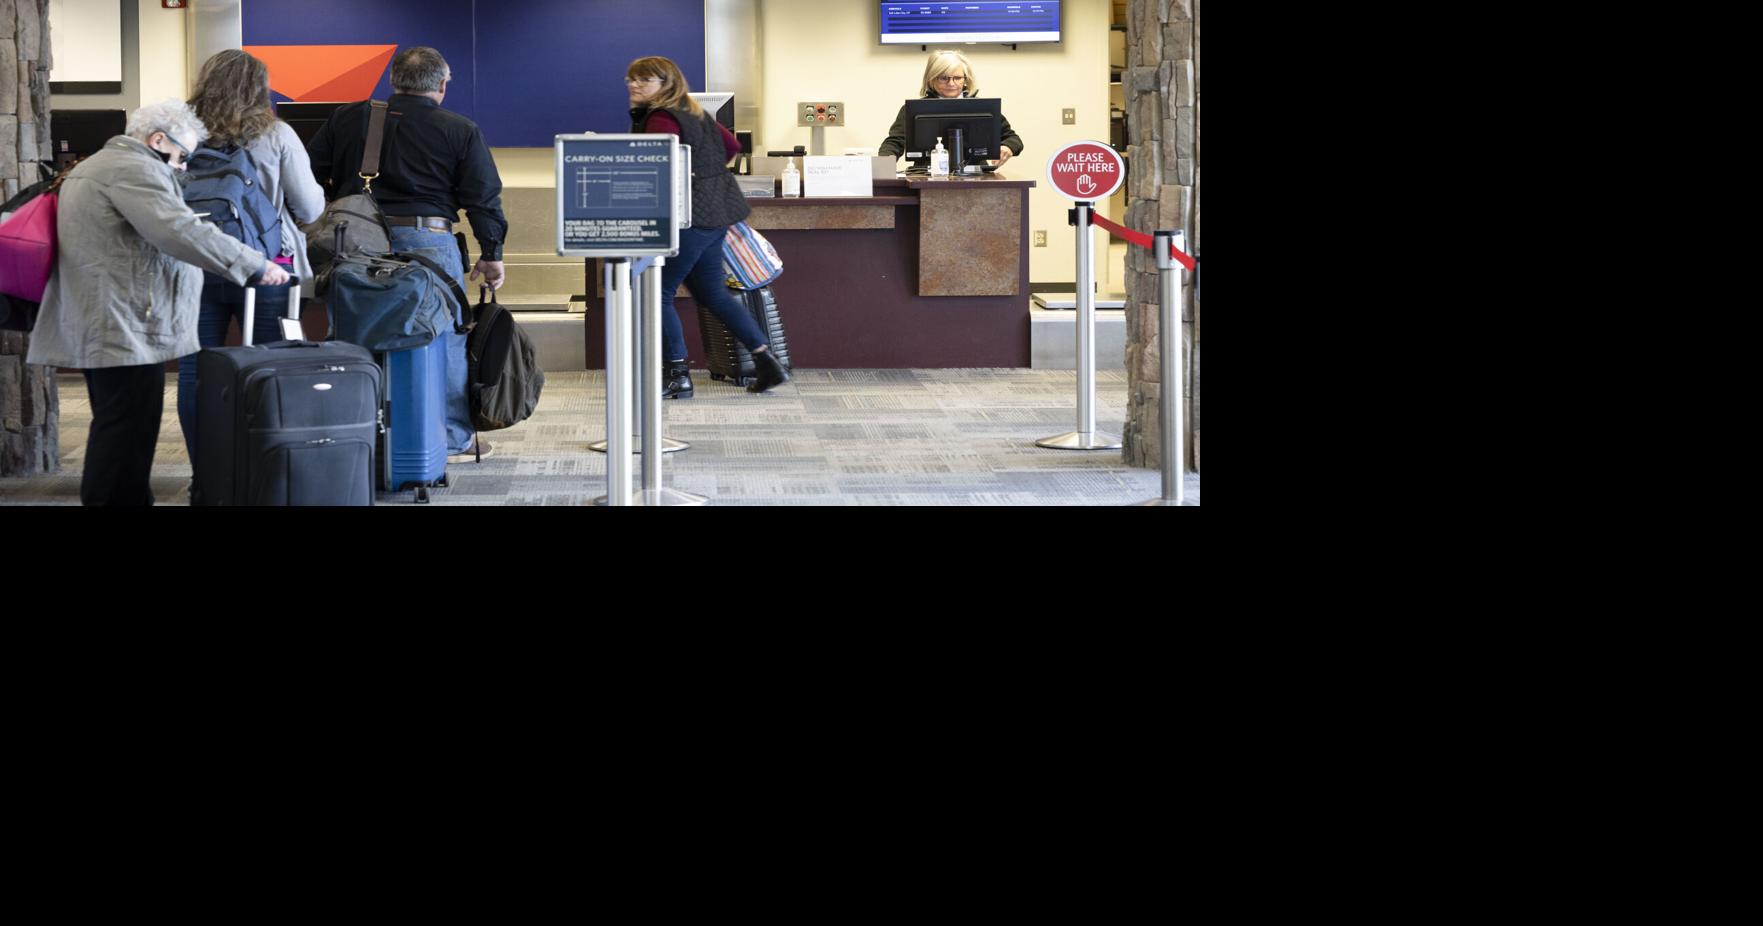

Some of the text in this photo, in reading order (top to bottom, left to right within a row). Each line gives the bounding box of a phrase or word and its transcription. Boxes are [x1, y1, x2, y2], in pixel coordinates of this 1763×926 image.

[565, 155, 613, 163] CARRY-ON
[616, 155, 635, 163] SIZE
[1067, 153, 1104, 162] PLEASE
[1057, 163, 1115, 172] WAIT HERE
